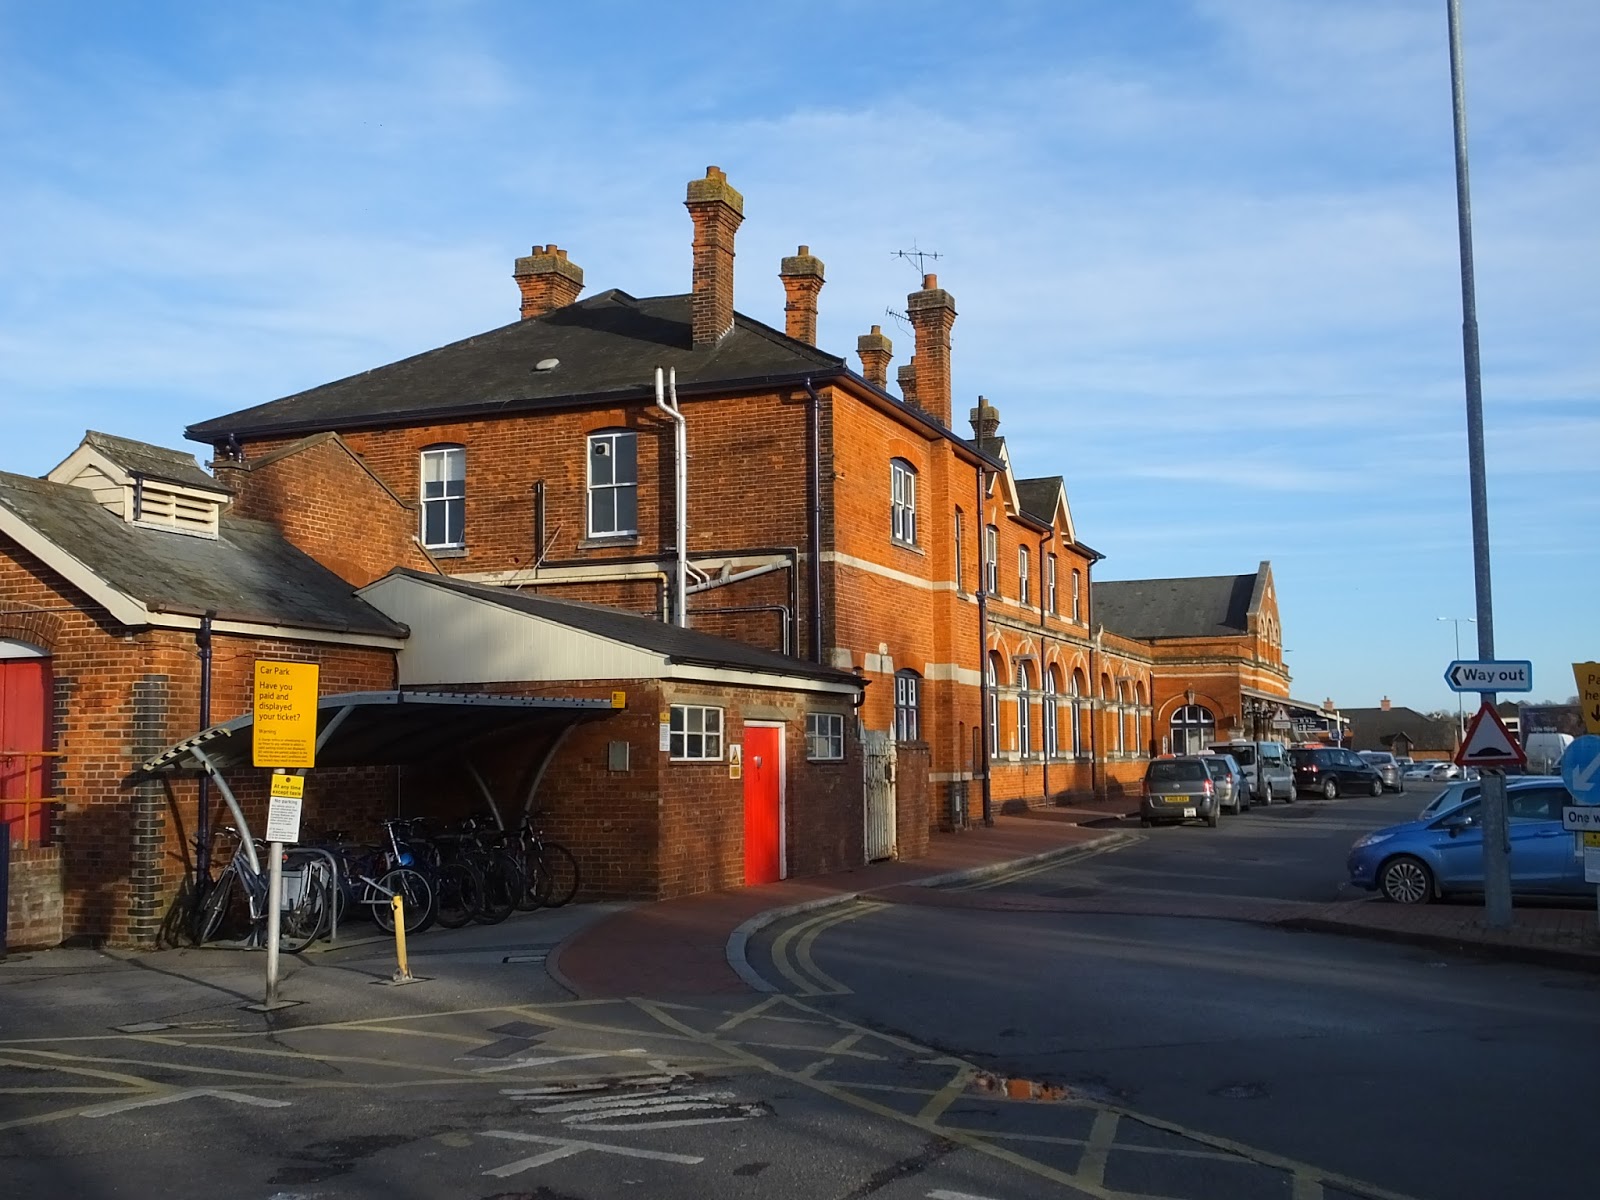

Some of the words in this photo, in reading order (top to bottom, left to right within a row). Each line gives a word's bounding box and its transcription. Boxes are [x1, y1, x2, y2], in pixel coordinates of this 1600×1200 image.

[260, 665, 272, 674] Car
[275, 666, 290, 675] Park
[1463, 668, 1495, 683] Way
[1499, 669, 1525, 681] out
[259, 681, 278, 690] Have
[279, 684, 293, 692] you
[259, 692, 274, 700] paid
[276, 693, 289, 701] and
[258, 701, 292, 712] displayed
[258, 713, 275, 721] your
[277, 713, 301, 721] ticket?
[1568, 811, 1590, 823] One
